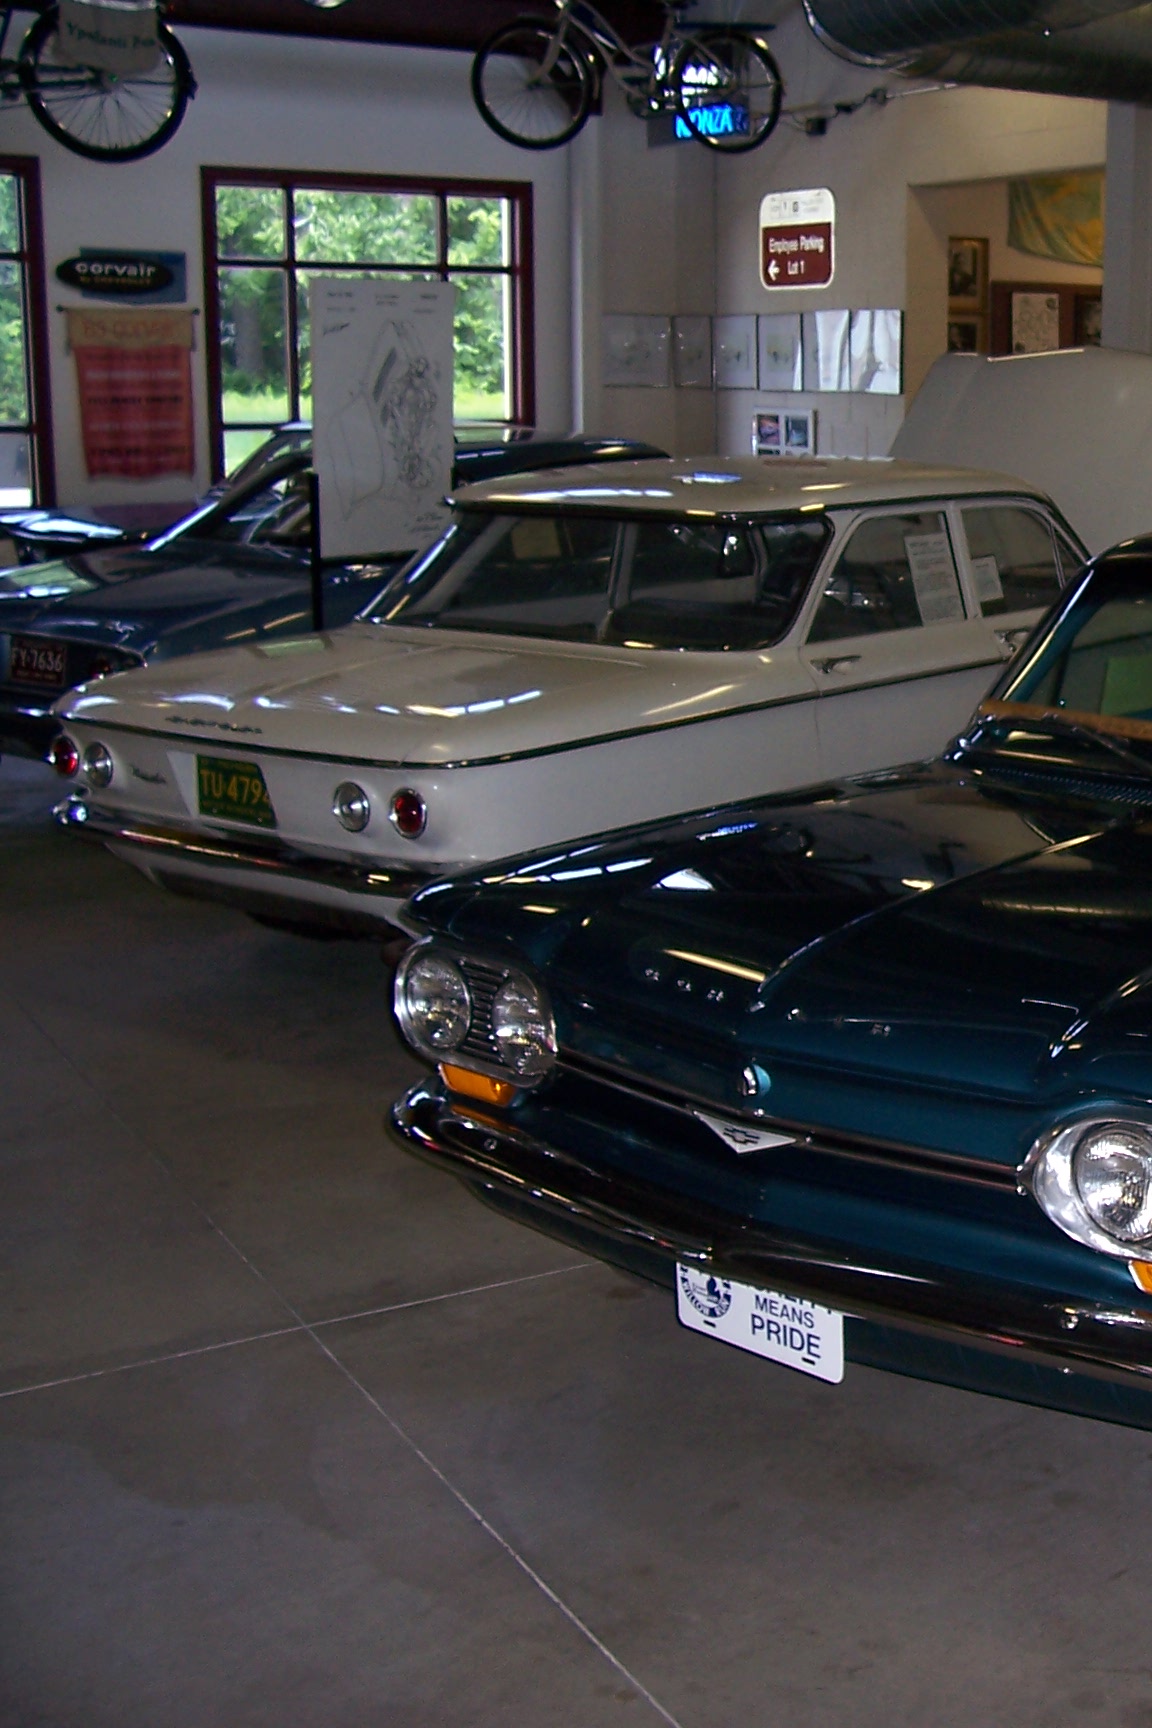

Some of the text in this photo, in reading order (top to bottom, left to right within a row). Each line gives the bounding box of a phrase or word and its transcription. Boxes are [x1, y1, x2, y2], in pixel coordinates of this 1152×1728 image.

[768, 234, 825, 254] Employee Parking
[75, 261, 157, 278] corvair
[755, 1294, 815, 1329] MEANS
[751, 1313, 821, 1359] PRIDE
